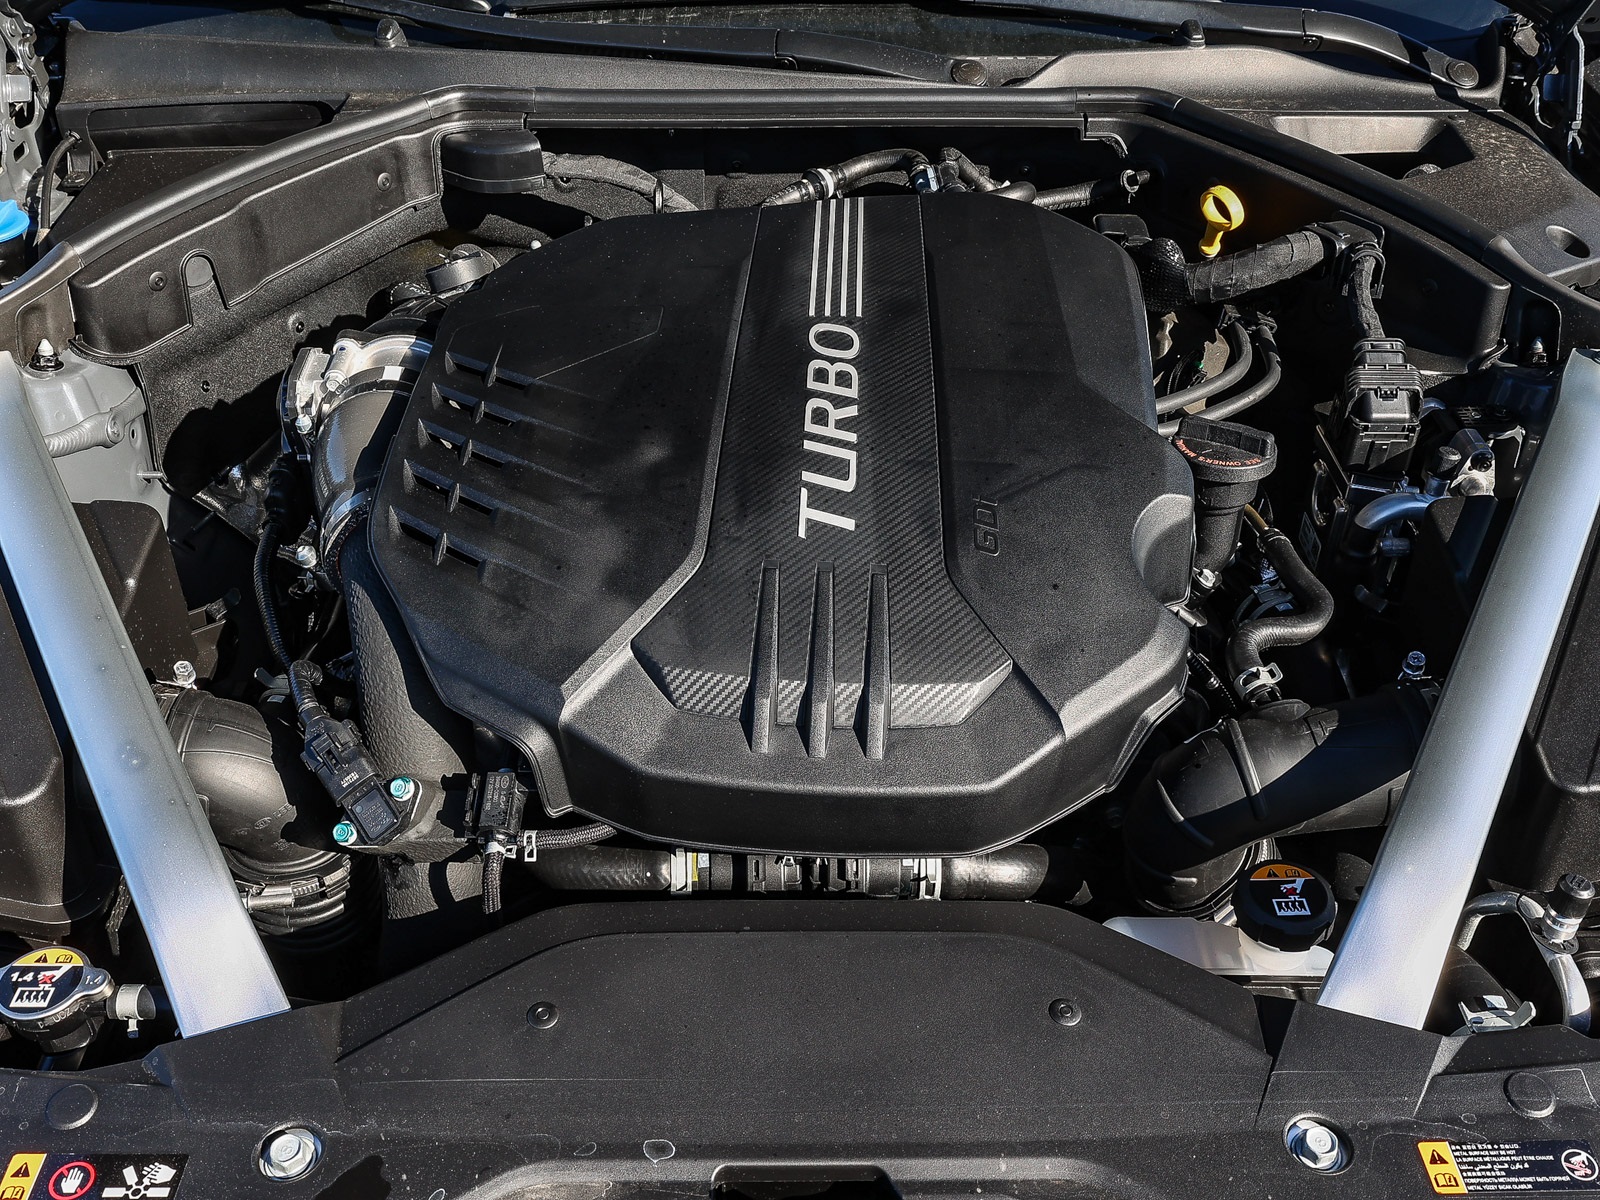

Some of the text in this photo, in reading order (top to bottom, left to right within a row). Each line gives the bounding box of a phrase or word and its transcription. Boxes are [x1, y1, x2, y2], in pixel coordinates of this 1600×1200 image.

[798, 323, 860, 538] TURBO
[1198, 456, 1241, 466] OWNER'S
[1244, 457, 1262, 466] SEE
[11, 971, 34, 982] 1.4
[85, 975, 102, 985] 1.4
